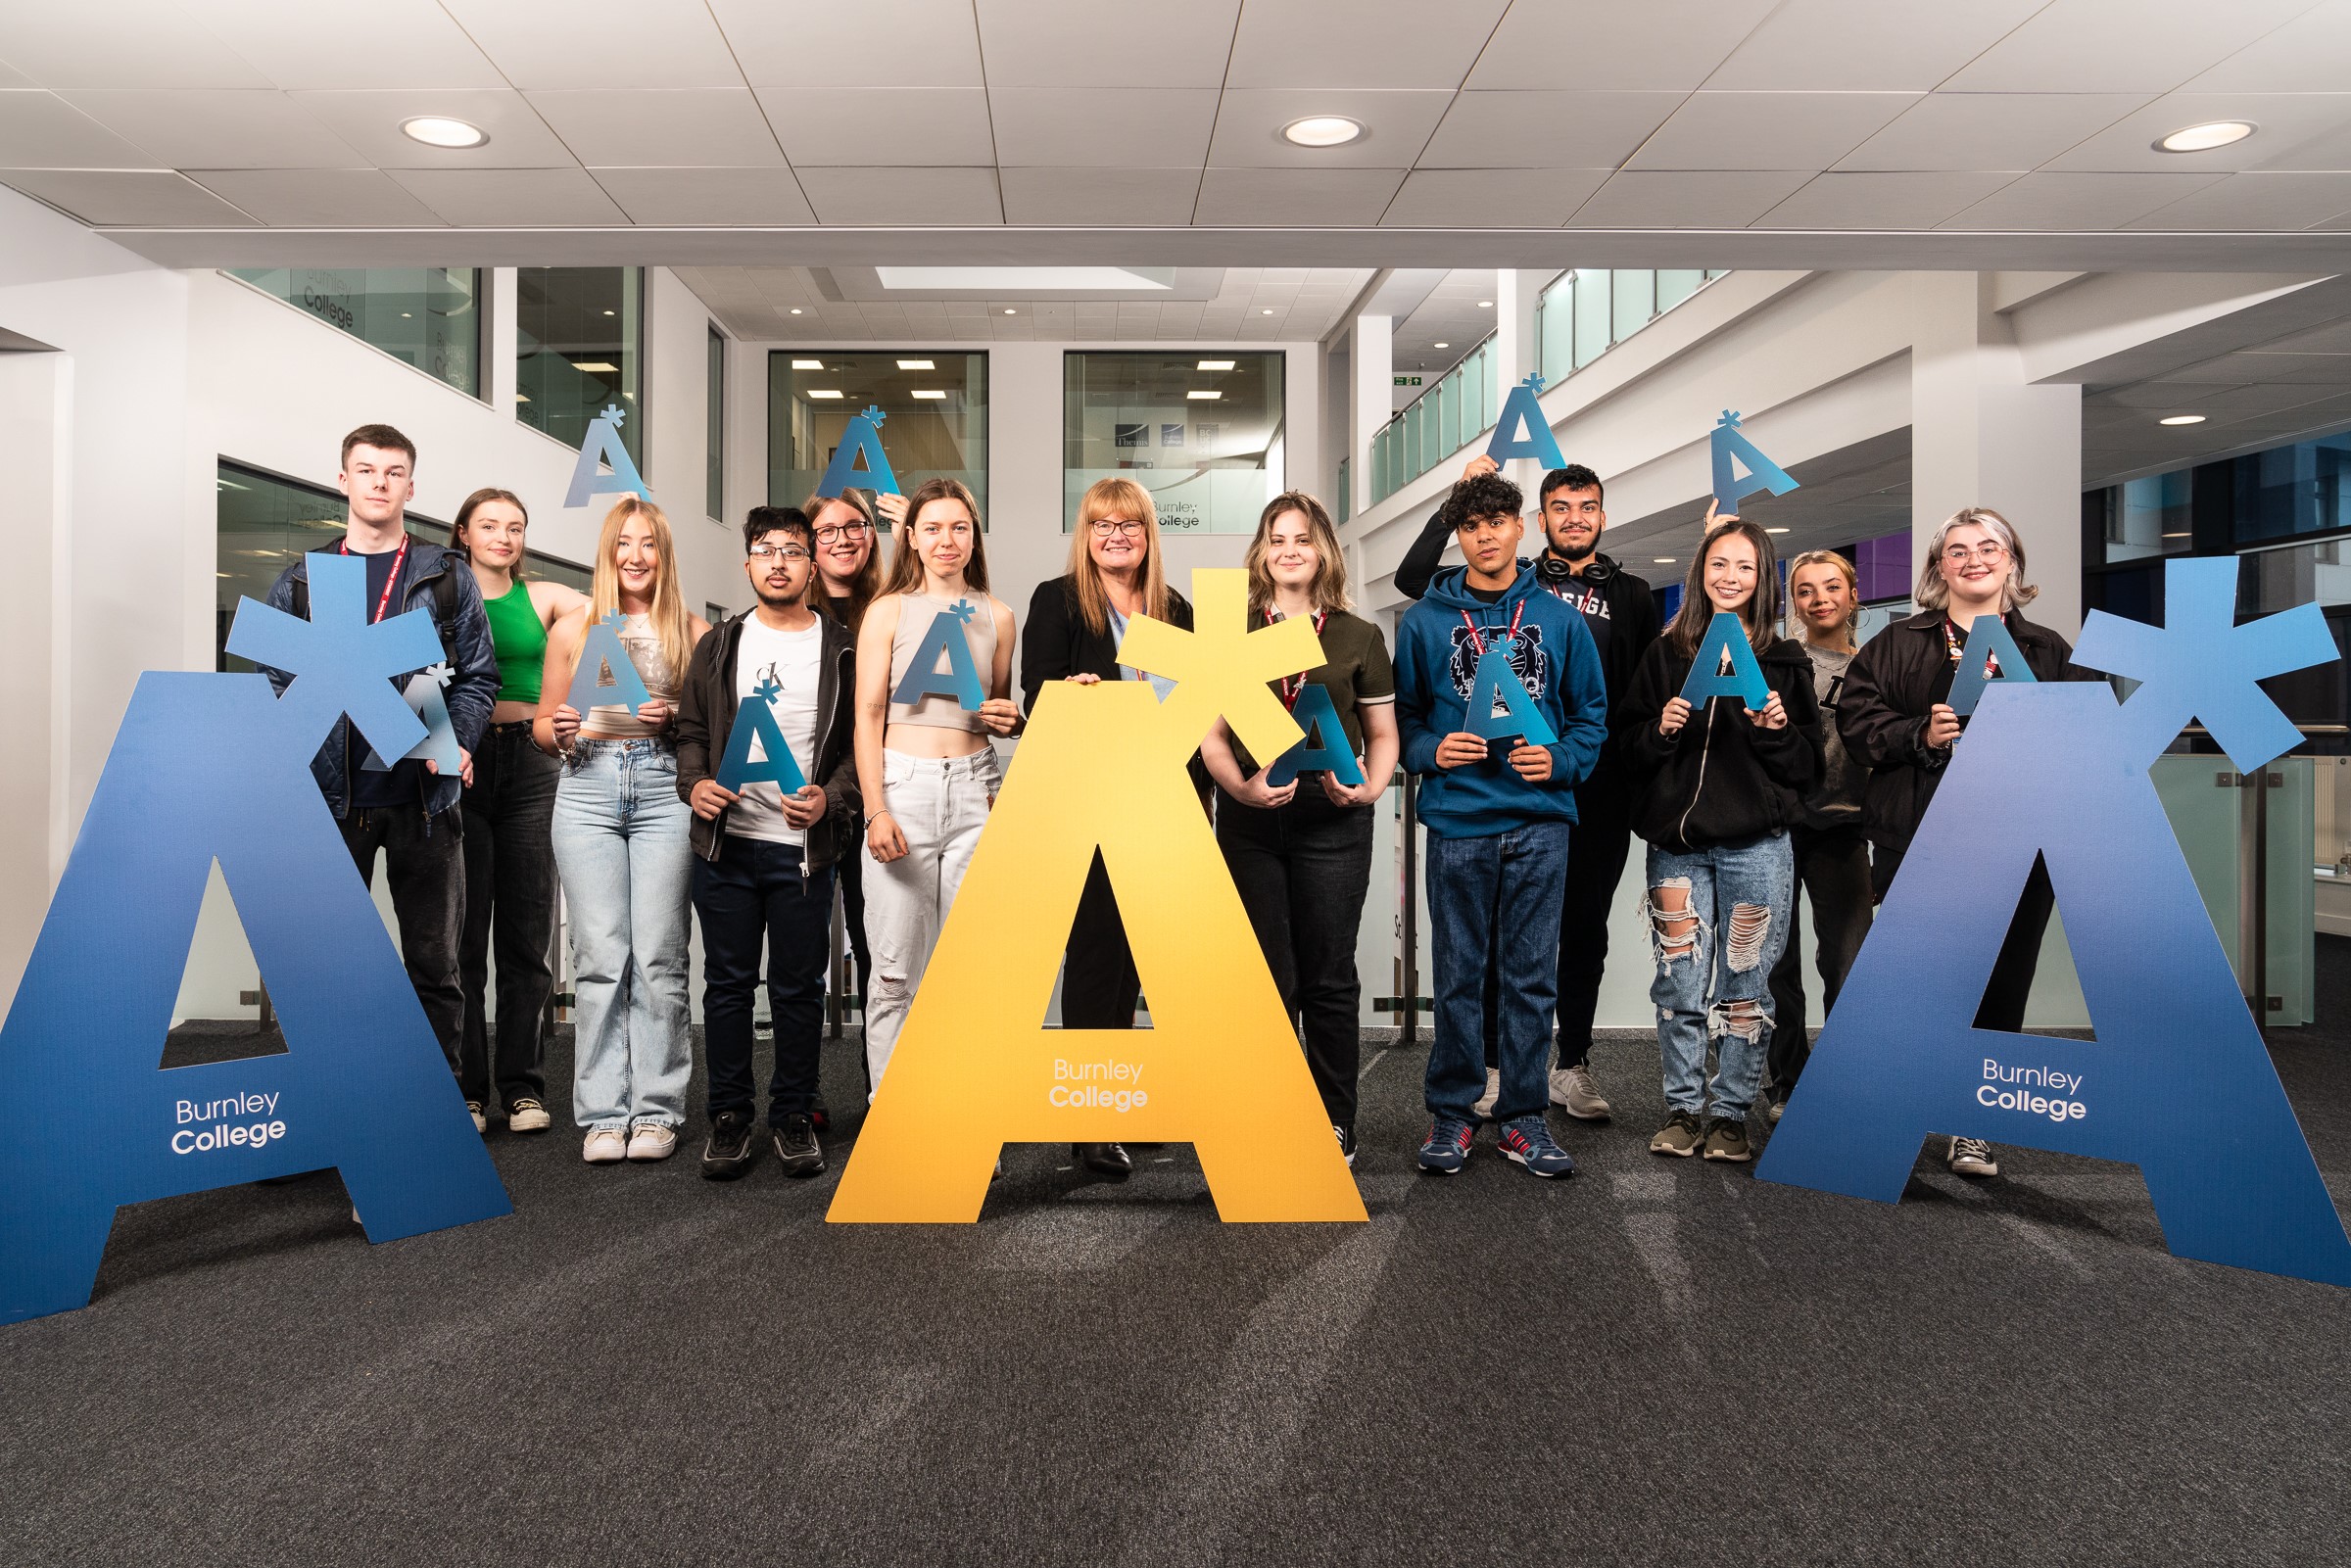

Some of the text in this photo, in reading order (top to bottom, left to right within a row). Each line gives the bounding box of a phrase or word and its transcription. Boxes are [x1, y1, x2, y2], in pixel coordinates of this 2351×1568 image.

[304, 285, 354, 329] College
[1118, 437, 1148, 447] Themis
[1156, 514, 1199, 529] ollege
[1054, 1059, 1143, 1085] Burnley
[1983, 1058, 2083, 1095] Burnley
[176, 1091, 279, 1124] Burnley
[1049, 1085, 1148, 1113] College
[1976, 1084, 2087, 1122] College
[171, 1120, 286, 1155] College
